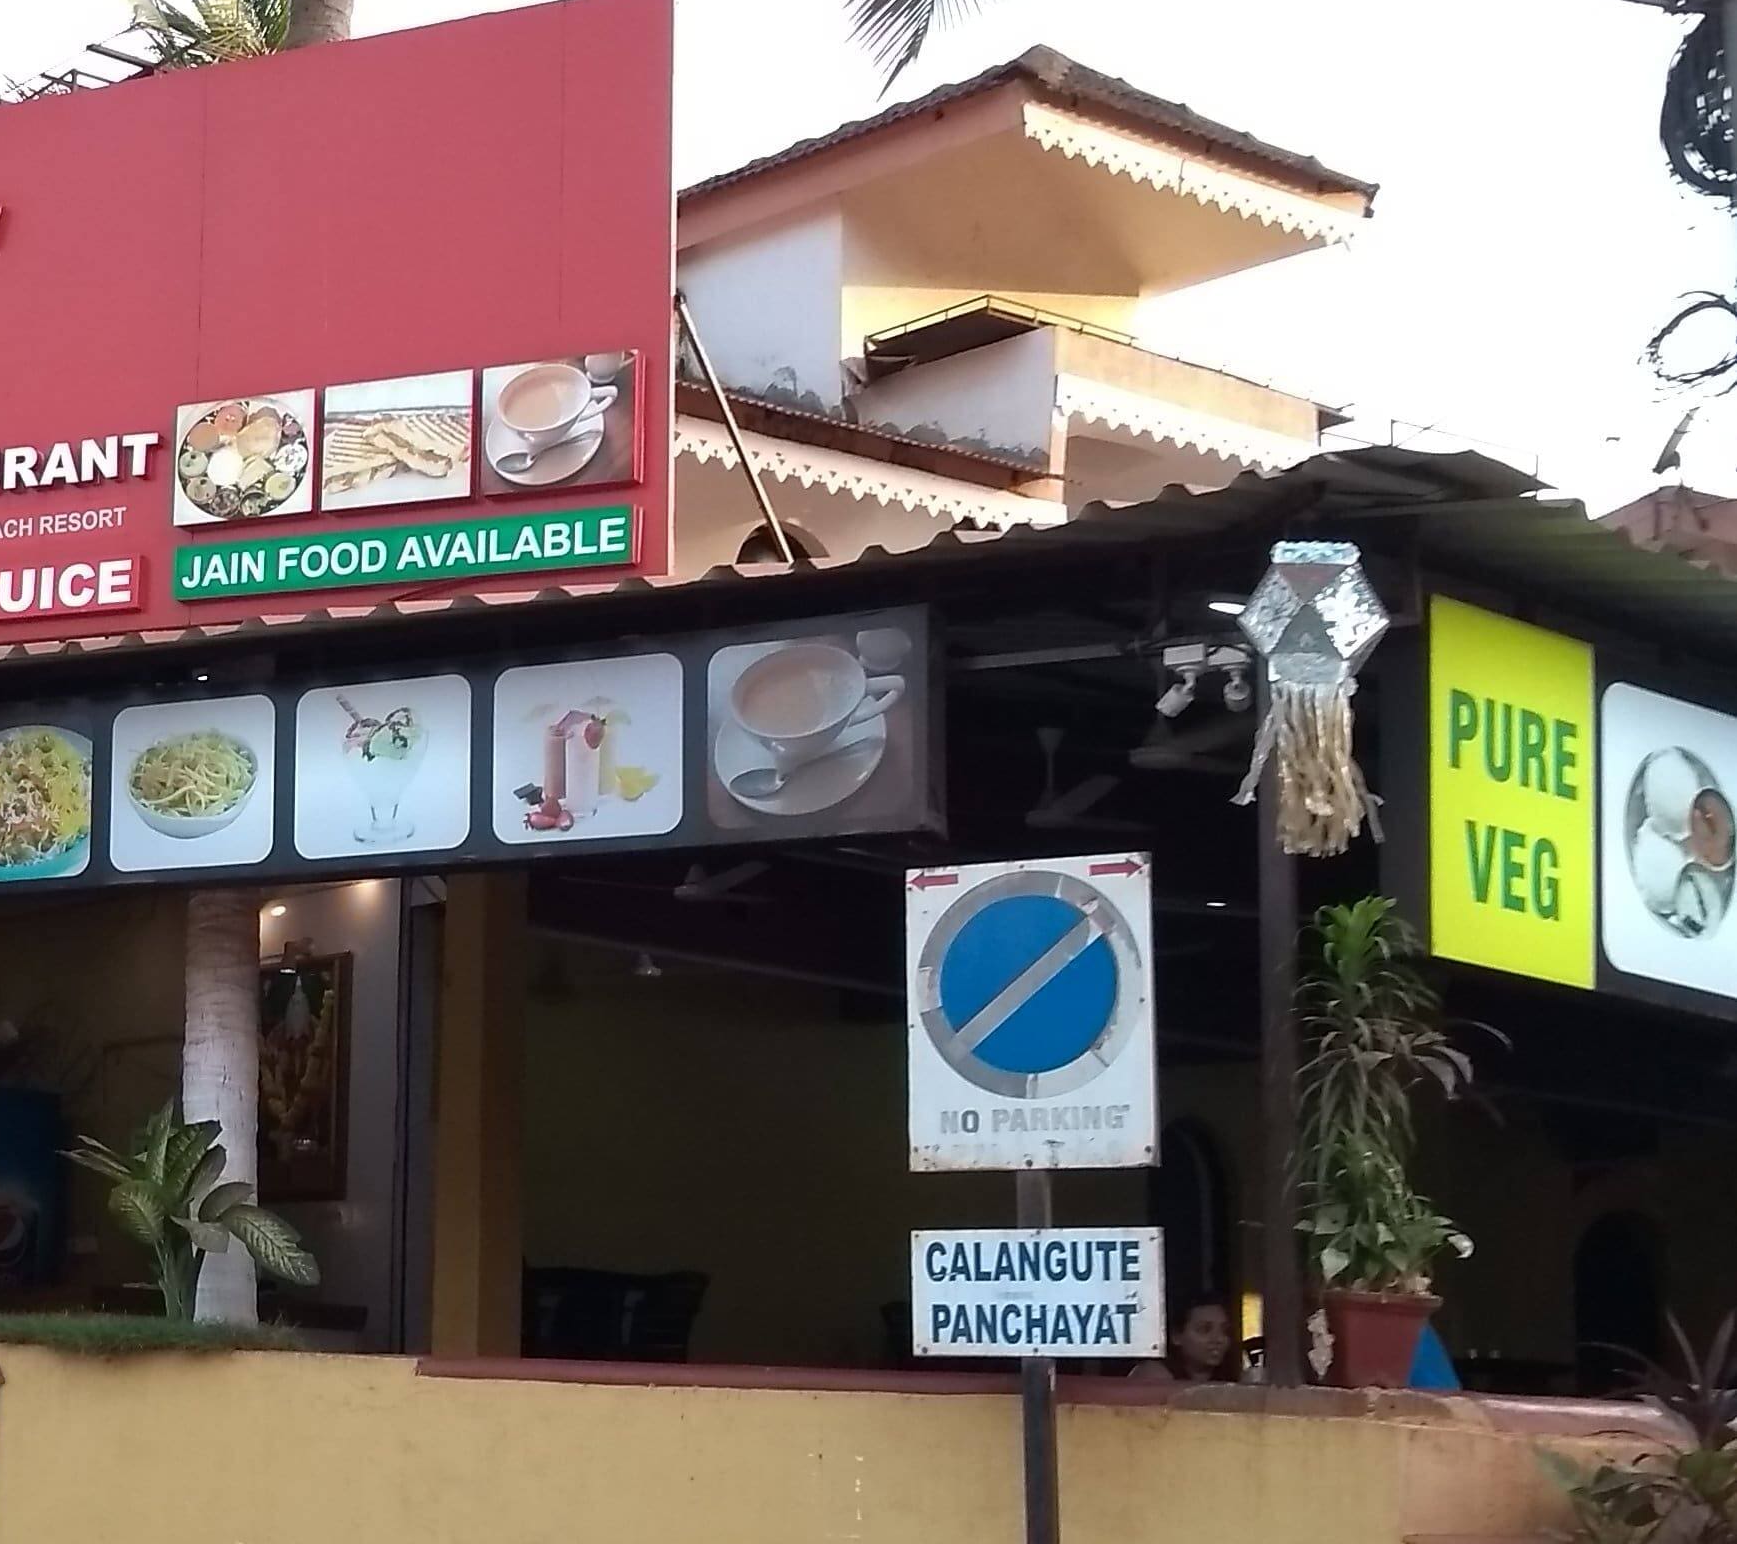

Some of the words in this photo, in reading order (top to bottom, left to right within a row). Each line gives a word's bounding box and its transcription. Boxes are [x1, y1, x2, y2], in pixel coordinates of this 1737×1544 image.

[38, 506, 127, 535] RESORT
[181, 550, 265, 590] JAIN
[277, 539, 389, 581] FOOD
[395, 517, 627, 571] AVAILABLE
[1447, 687, 1578, 802] PURE
[1465, 818, 1560, 922] VEG
[940, 1109, 980, 1135] NO
[991, 1103, 1130, 1133] PARKING
[925, 1239, 1141, 1284] CALANGUTE
[931, 1301, 1139, 1347] PANCHAYAT
